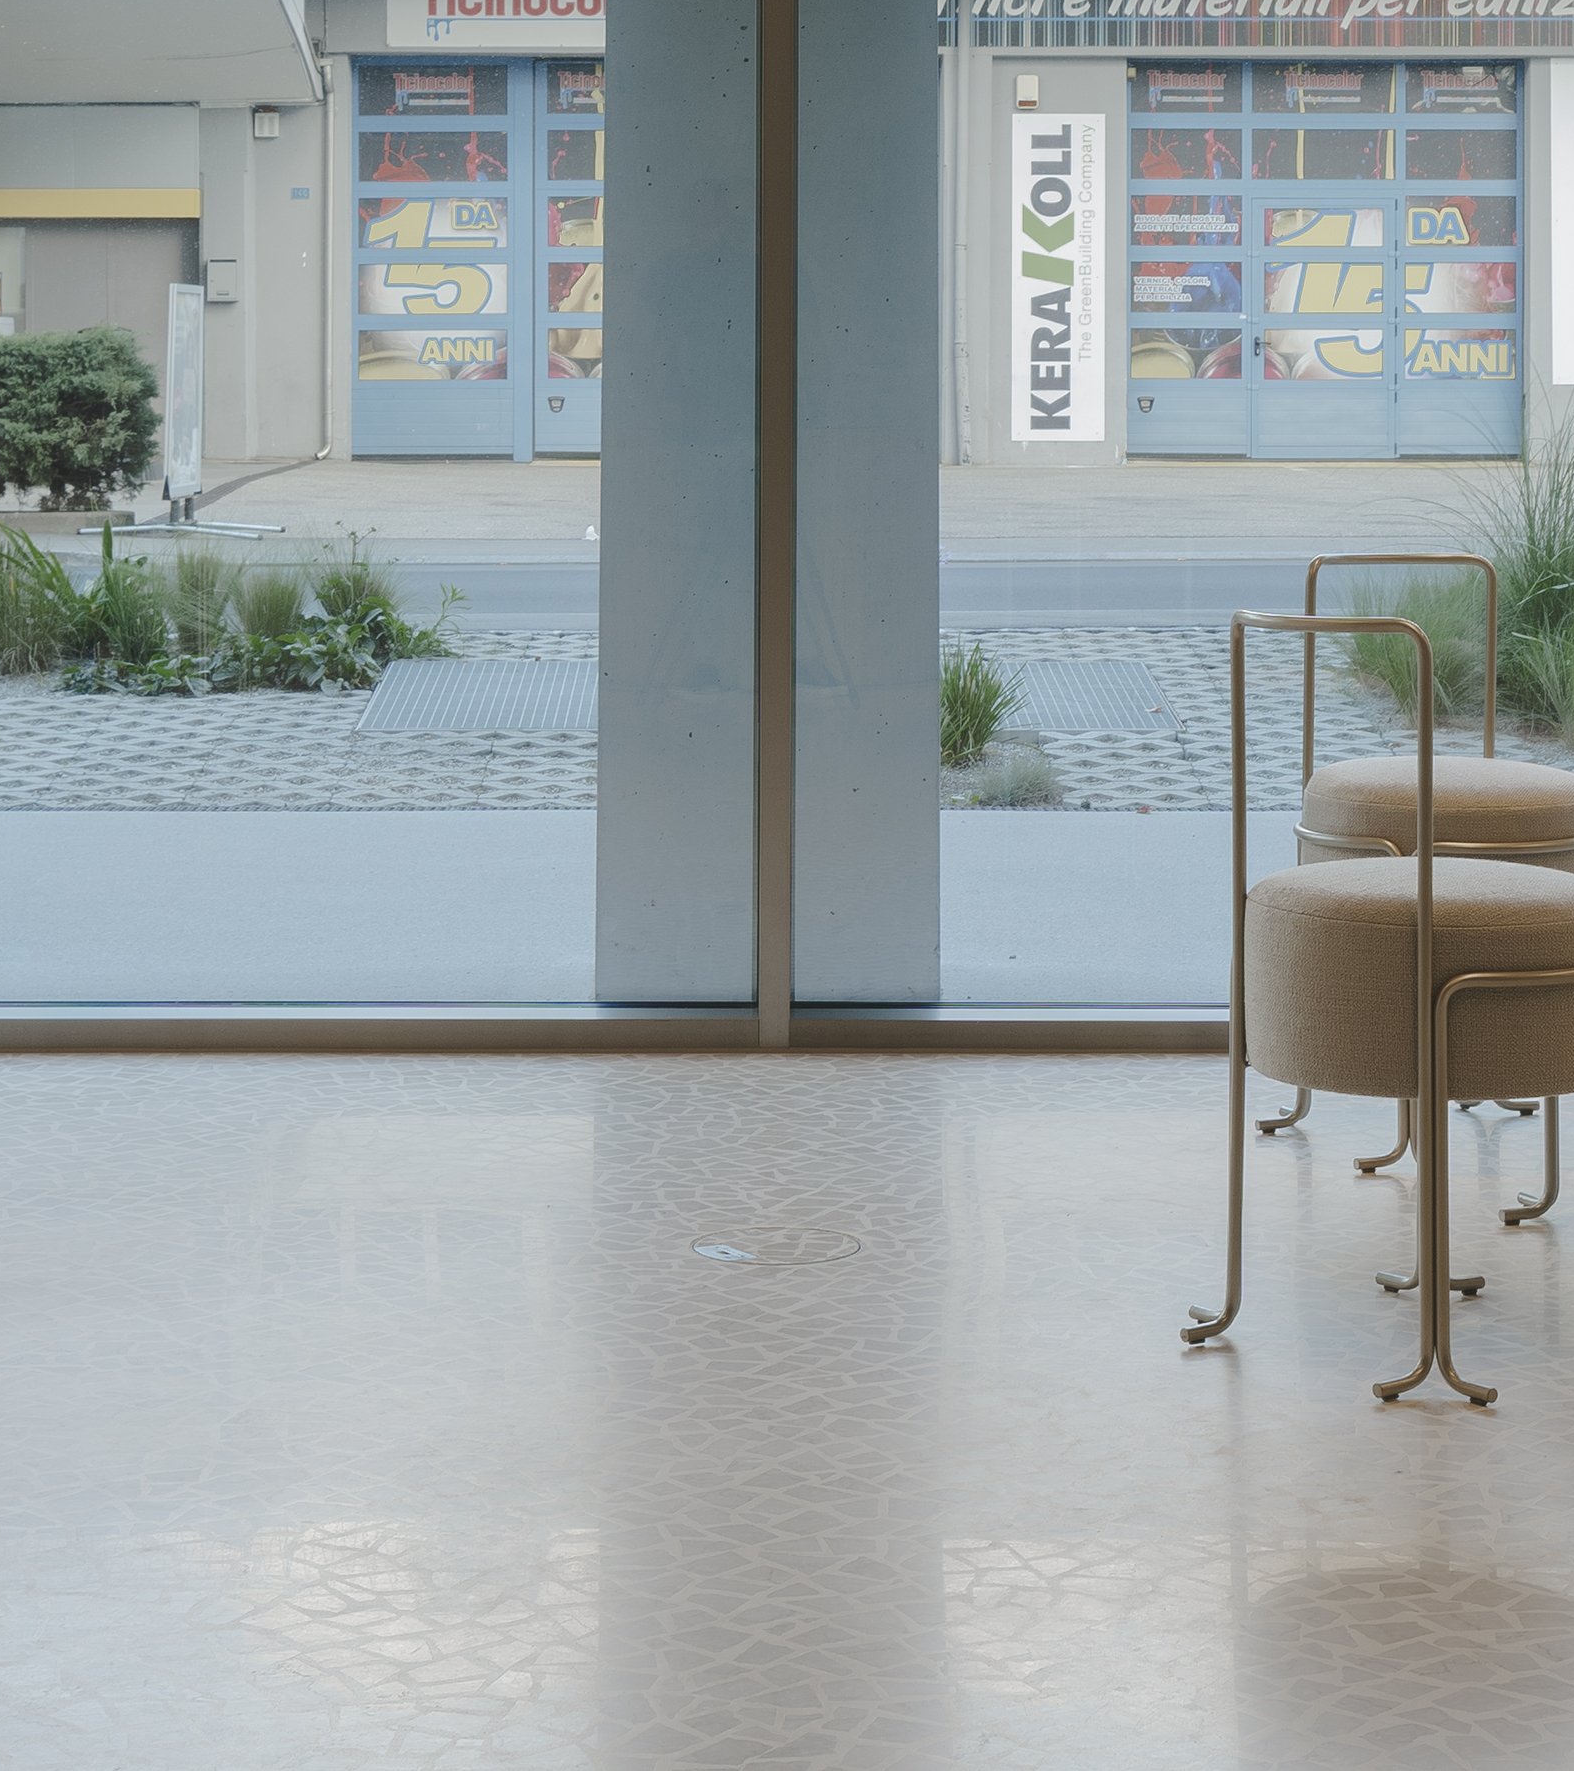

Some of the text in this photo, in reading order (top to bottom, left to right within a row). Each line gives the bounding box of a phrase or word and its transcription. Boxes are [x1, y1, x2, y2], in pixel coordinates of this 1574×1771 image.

[393, 72, 475, 92] Ticinocolor
[1146, 70, 1226, 88] Ticinocolor
[1284, 70, 1364, 88] Ticinocolor
[454, 202, 496, 228] DA
[1134, 215, 1225, 223] RIVOLGITI AI NOSTRI
[1134, 224, 1239, 232] ADDETTI SPECIALIZZATI
[1410, 209, 1468, 242] DA
[1078, 123, 1096, 363] The GreenBuilding Company
[1022, 123, 1075, 431] KERAKOLL
[1134, 286, 1182, 294] MATERIALI
[1134, 294, 1193, 302] PER EDILIZIA
[419, 338, 496, 364] ANNI
[1411, 341, 1513, 375] ANNI
